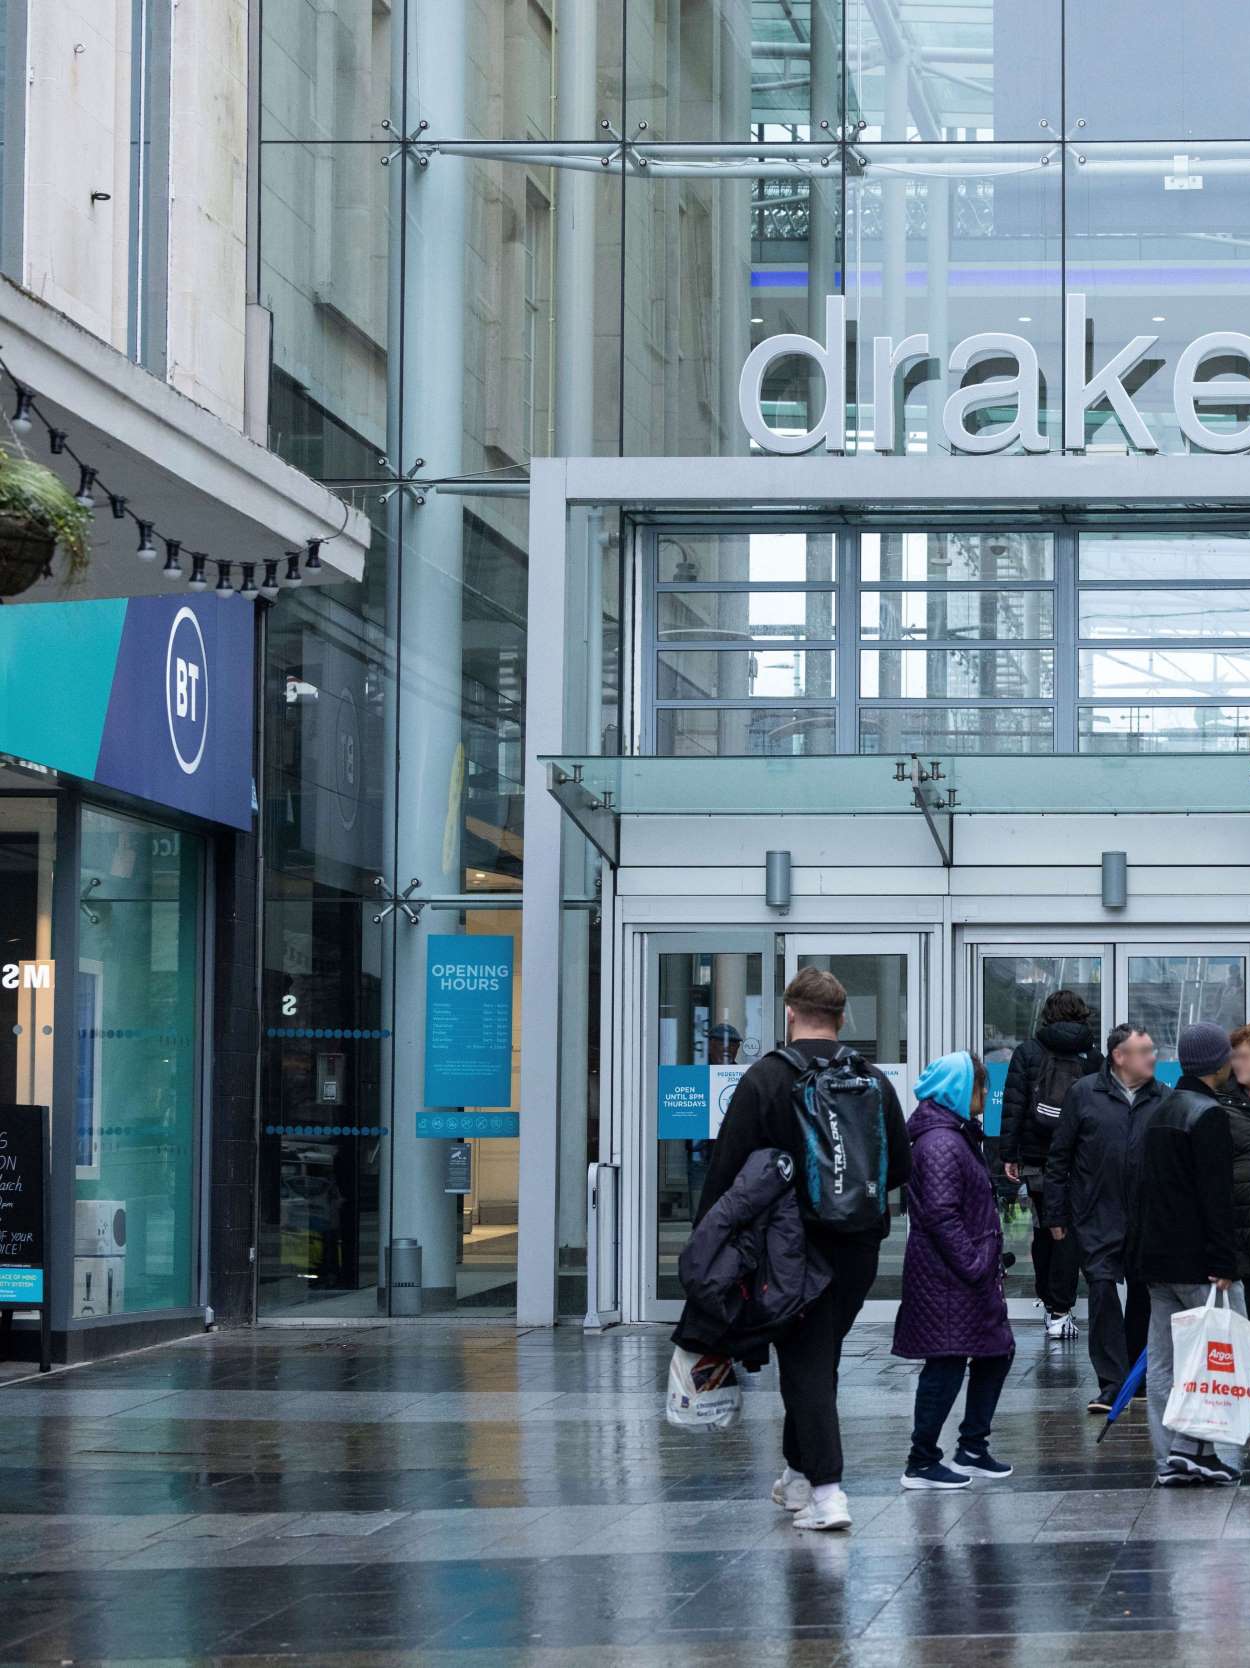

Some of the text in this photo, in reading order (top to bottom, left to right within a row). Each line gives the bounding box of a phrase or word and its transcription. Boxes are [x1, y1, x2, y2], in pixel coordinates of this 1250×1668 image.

[176, 656, 200, 722] BT
[431, 964, 509, 978] OPENING
[440, 978, 500, 991] HOURS
[828, 1109, 840, 1141] DRY
[834, 1143, 843, 1194] ULTRA
[0, 1173, 23, 1192] arch
[11, 1232, 34, 1243] YOUR
[1200, 1382, 1209, 1394] a
